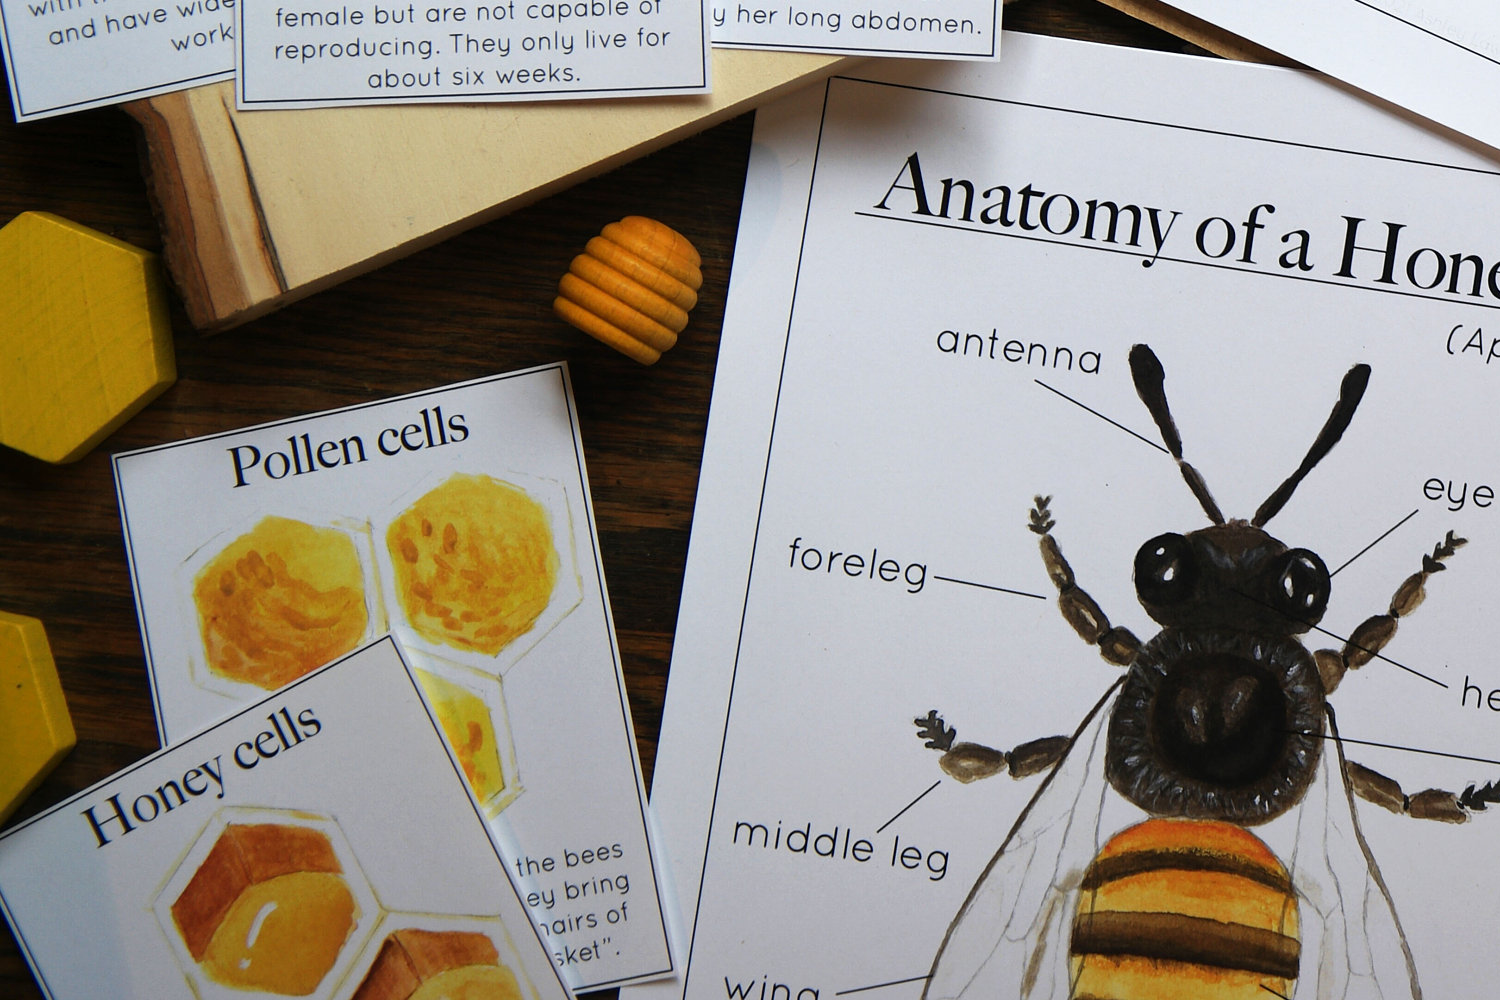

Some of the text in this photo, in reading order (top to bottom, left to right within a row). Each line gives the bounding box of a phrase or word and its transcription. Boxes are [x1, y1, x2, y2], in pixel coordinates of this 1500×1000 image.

[49, 9, 167, 45] and have
[738, 4, 981, 34] her long abdomen.
[276, 27, 670, 64] reproducing. They only live for
[368, 63, 580, 88] about six weeks.
[873, 151, 1183, 268] Anatomy
[1195, 204, 1276, 264] of
[1278, 229, 1315, 271] a
[937, 328, 1101, 375] antenna
[226, 406, 469, 488] Pollen cells
[1423, 478, 1494, 512] eye
[789, 537, 926, 594] foreleg
[80, 707, 321, 848] Honey cells
[516, 844, 623, 877] the bees
[733, 820, 949, 881] middle leg
[564, 875, 629, 900] bring
[607, 901, 627, 924] of
